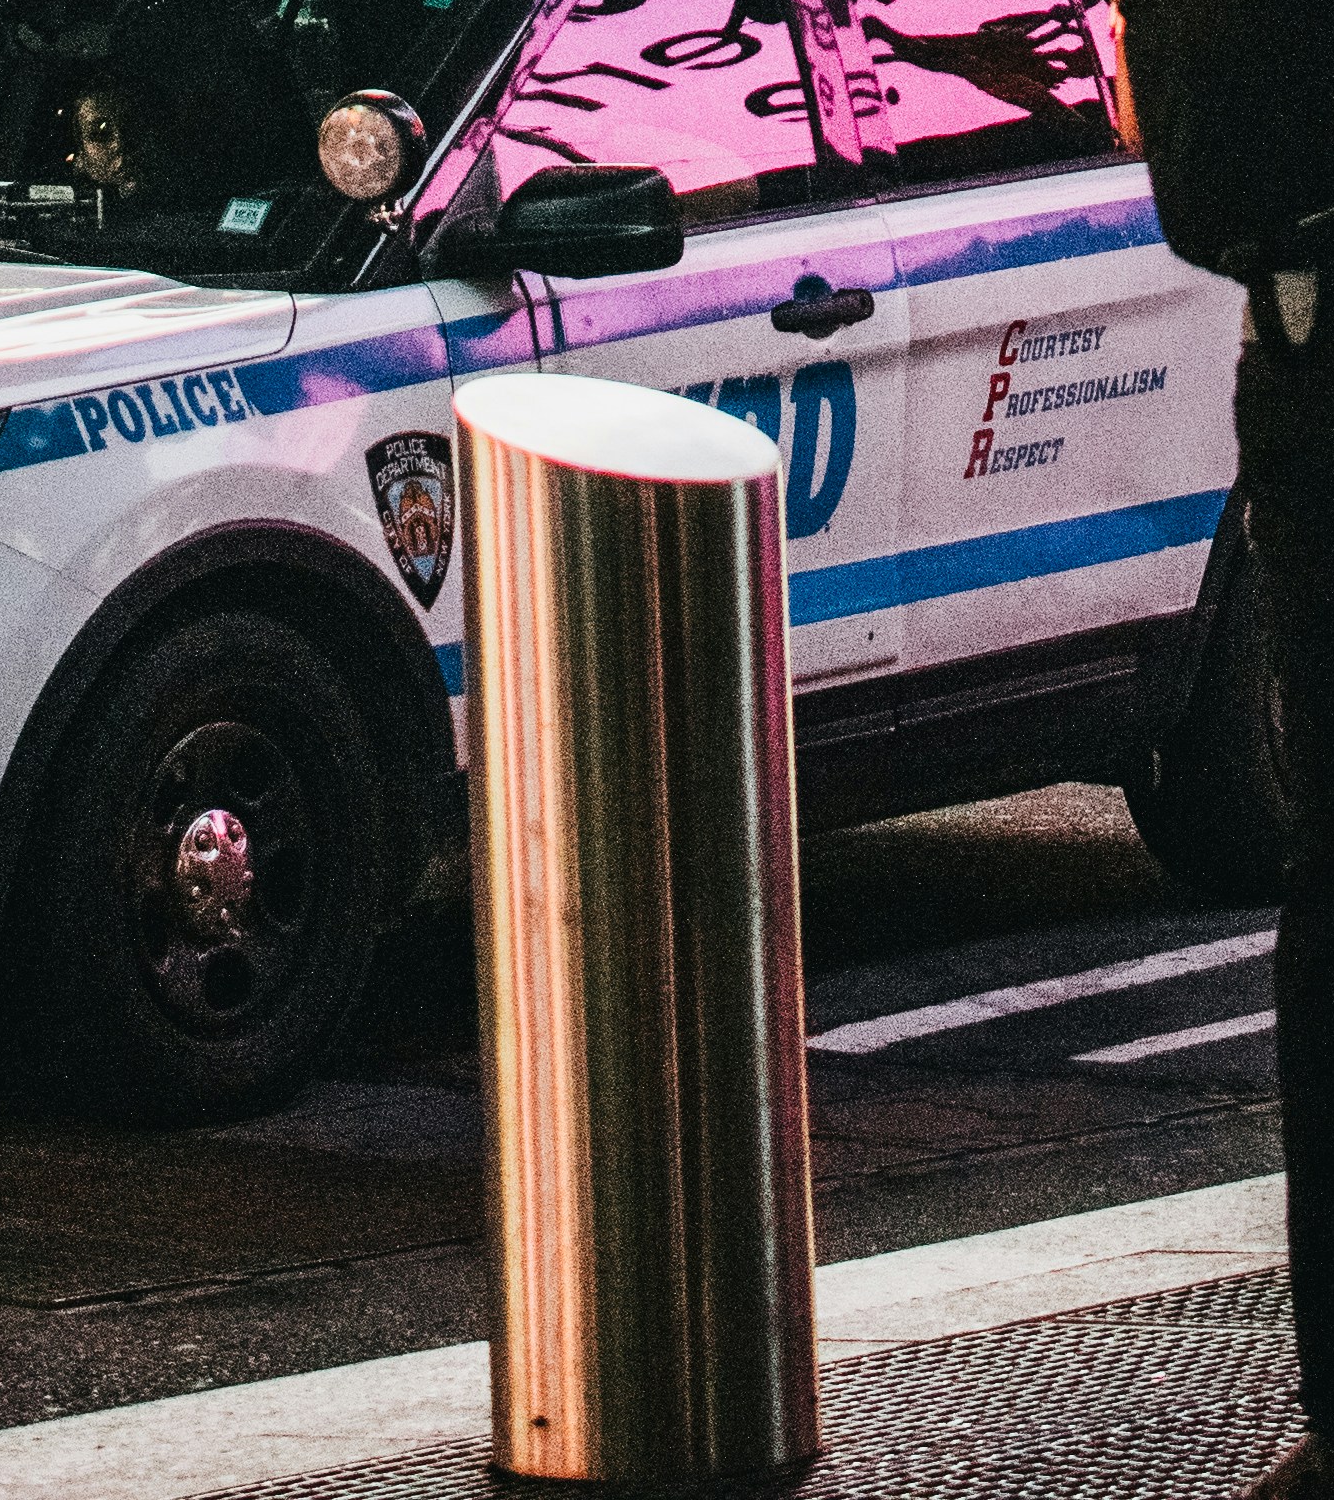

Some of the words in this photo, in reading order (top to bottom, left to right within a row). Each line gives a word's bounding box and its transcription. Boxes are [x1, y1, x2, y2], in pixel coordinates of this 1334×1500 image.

[998, 318, 1107, 367] COURTESY
[72, 368, 247, 453] POLICE
[982, 366, 1168, 423] PROFESSIONALISM
[375, 456, 447, 492] DEPARTMENT
[385, 438, 427, 460] POLICE
[963, 427, 1066, 480] RESPECT
